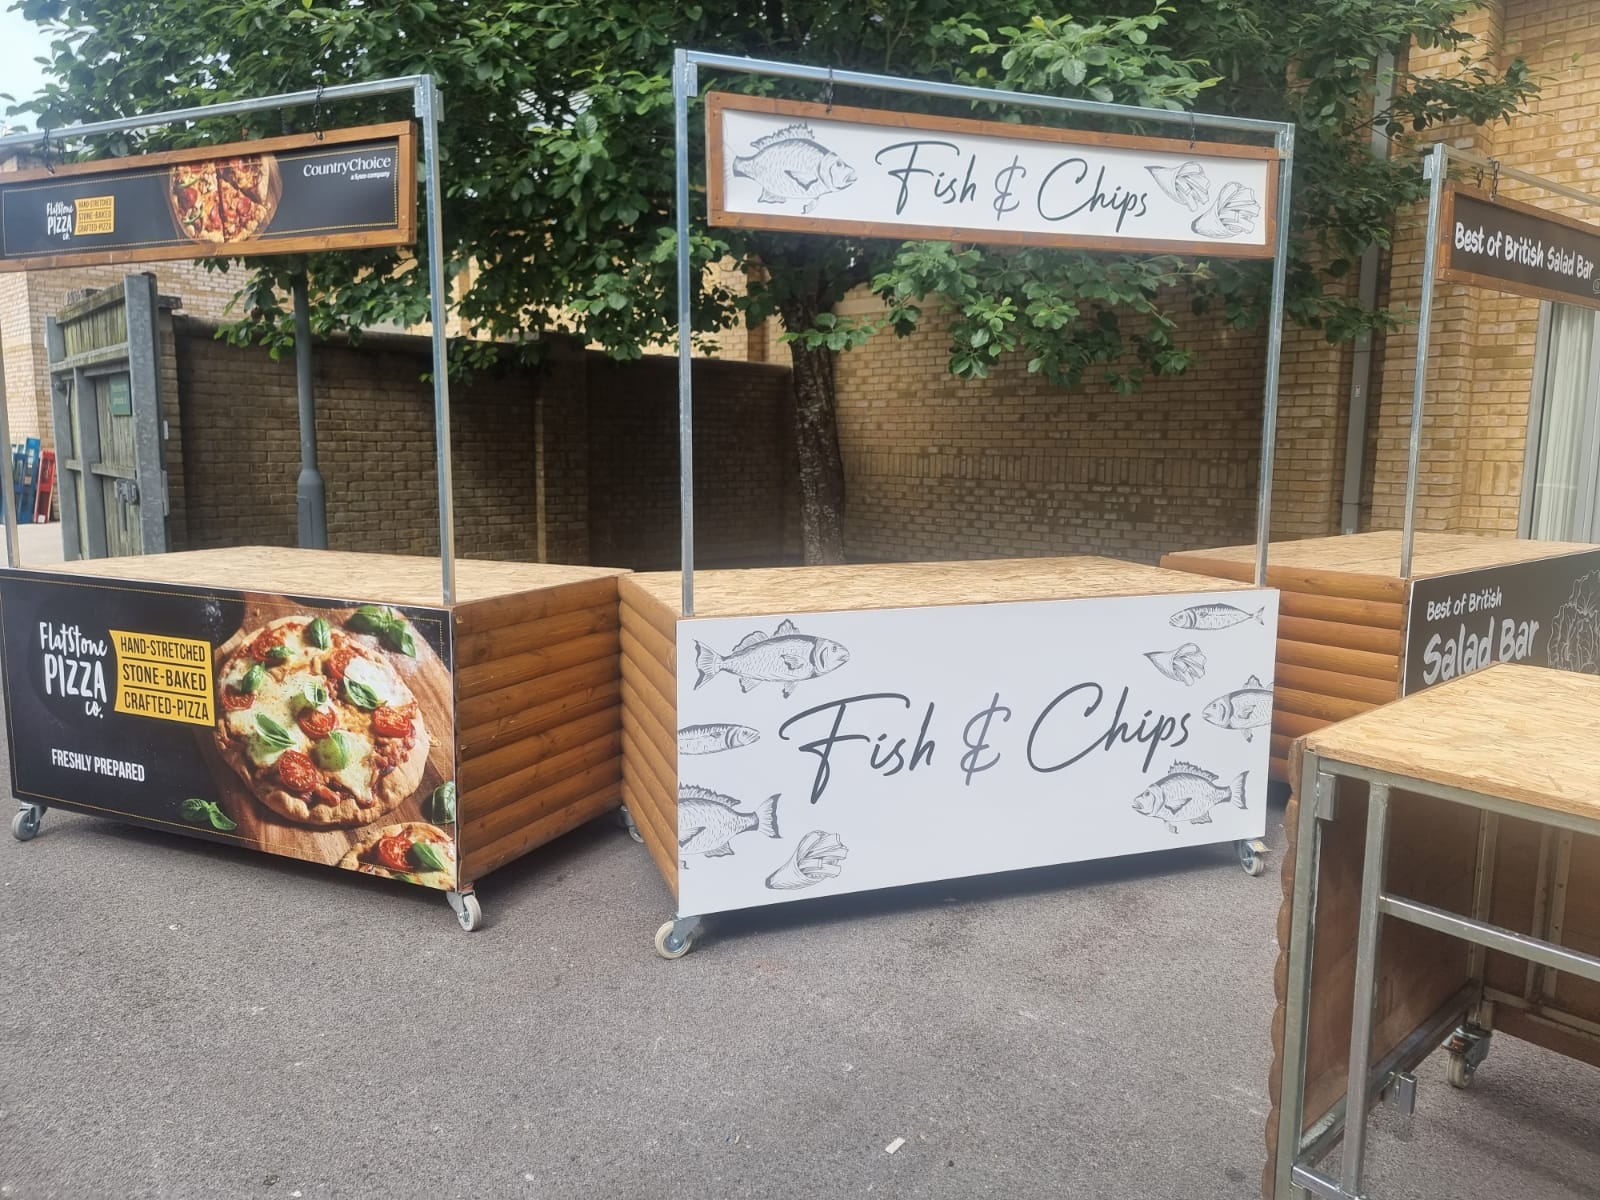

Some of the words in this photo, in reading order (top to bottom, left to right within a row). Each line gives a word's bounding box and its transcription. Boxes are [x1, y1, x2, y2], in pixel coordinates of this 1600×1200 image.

[303, 156, 391, 177] CountryChoice
[875, 140, 977, 215] Fish
[993, 154, 1027, 221] &
[1037, 157, 1151, 233] Chips
[47, 214, 73, 235] PIZZA
[1454, 222, 1485, 255] Best
[1486, 231, 1503, 259] of
[1504, 234, 1544, 269] British
[1546, 246, 1576, 276] Salad
[1576, 254, 1595, 281] Bar
[1426, 595, 1451, 622] Best
[1453, 592, 1467, 616] of
[1468, 586, 1503, 613] British
[120, 635, 206, 663] HAND-STRETCHED
[1423, 616, 1495, 686] Salad
[1499, 618, 1540, 663] Bar
[44, 653, 107, 704] PIZZA
[122, 663, 207, 692] STONE-BAKED
[124, 691, 210, 721] CRAFTED-PIZZA
[778, 691, 936, 804] Fish
[960, 691, 1012, 786] &
[1026, 682, 1192, 773] Chips
[51, 748, 92, 773] FRESHLY
[94, 755, 145, 782] PREPARED
